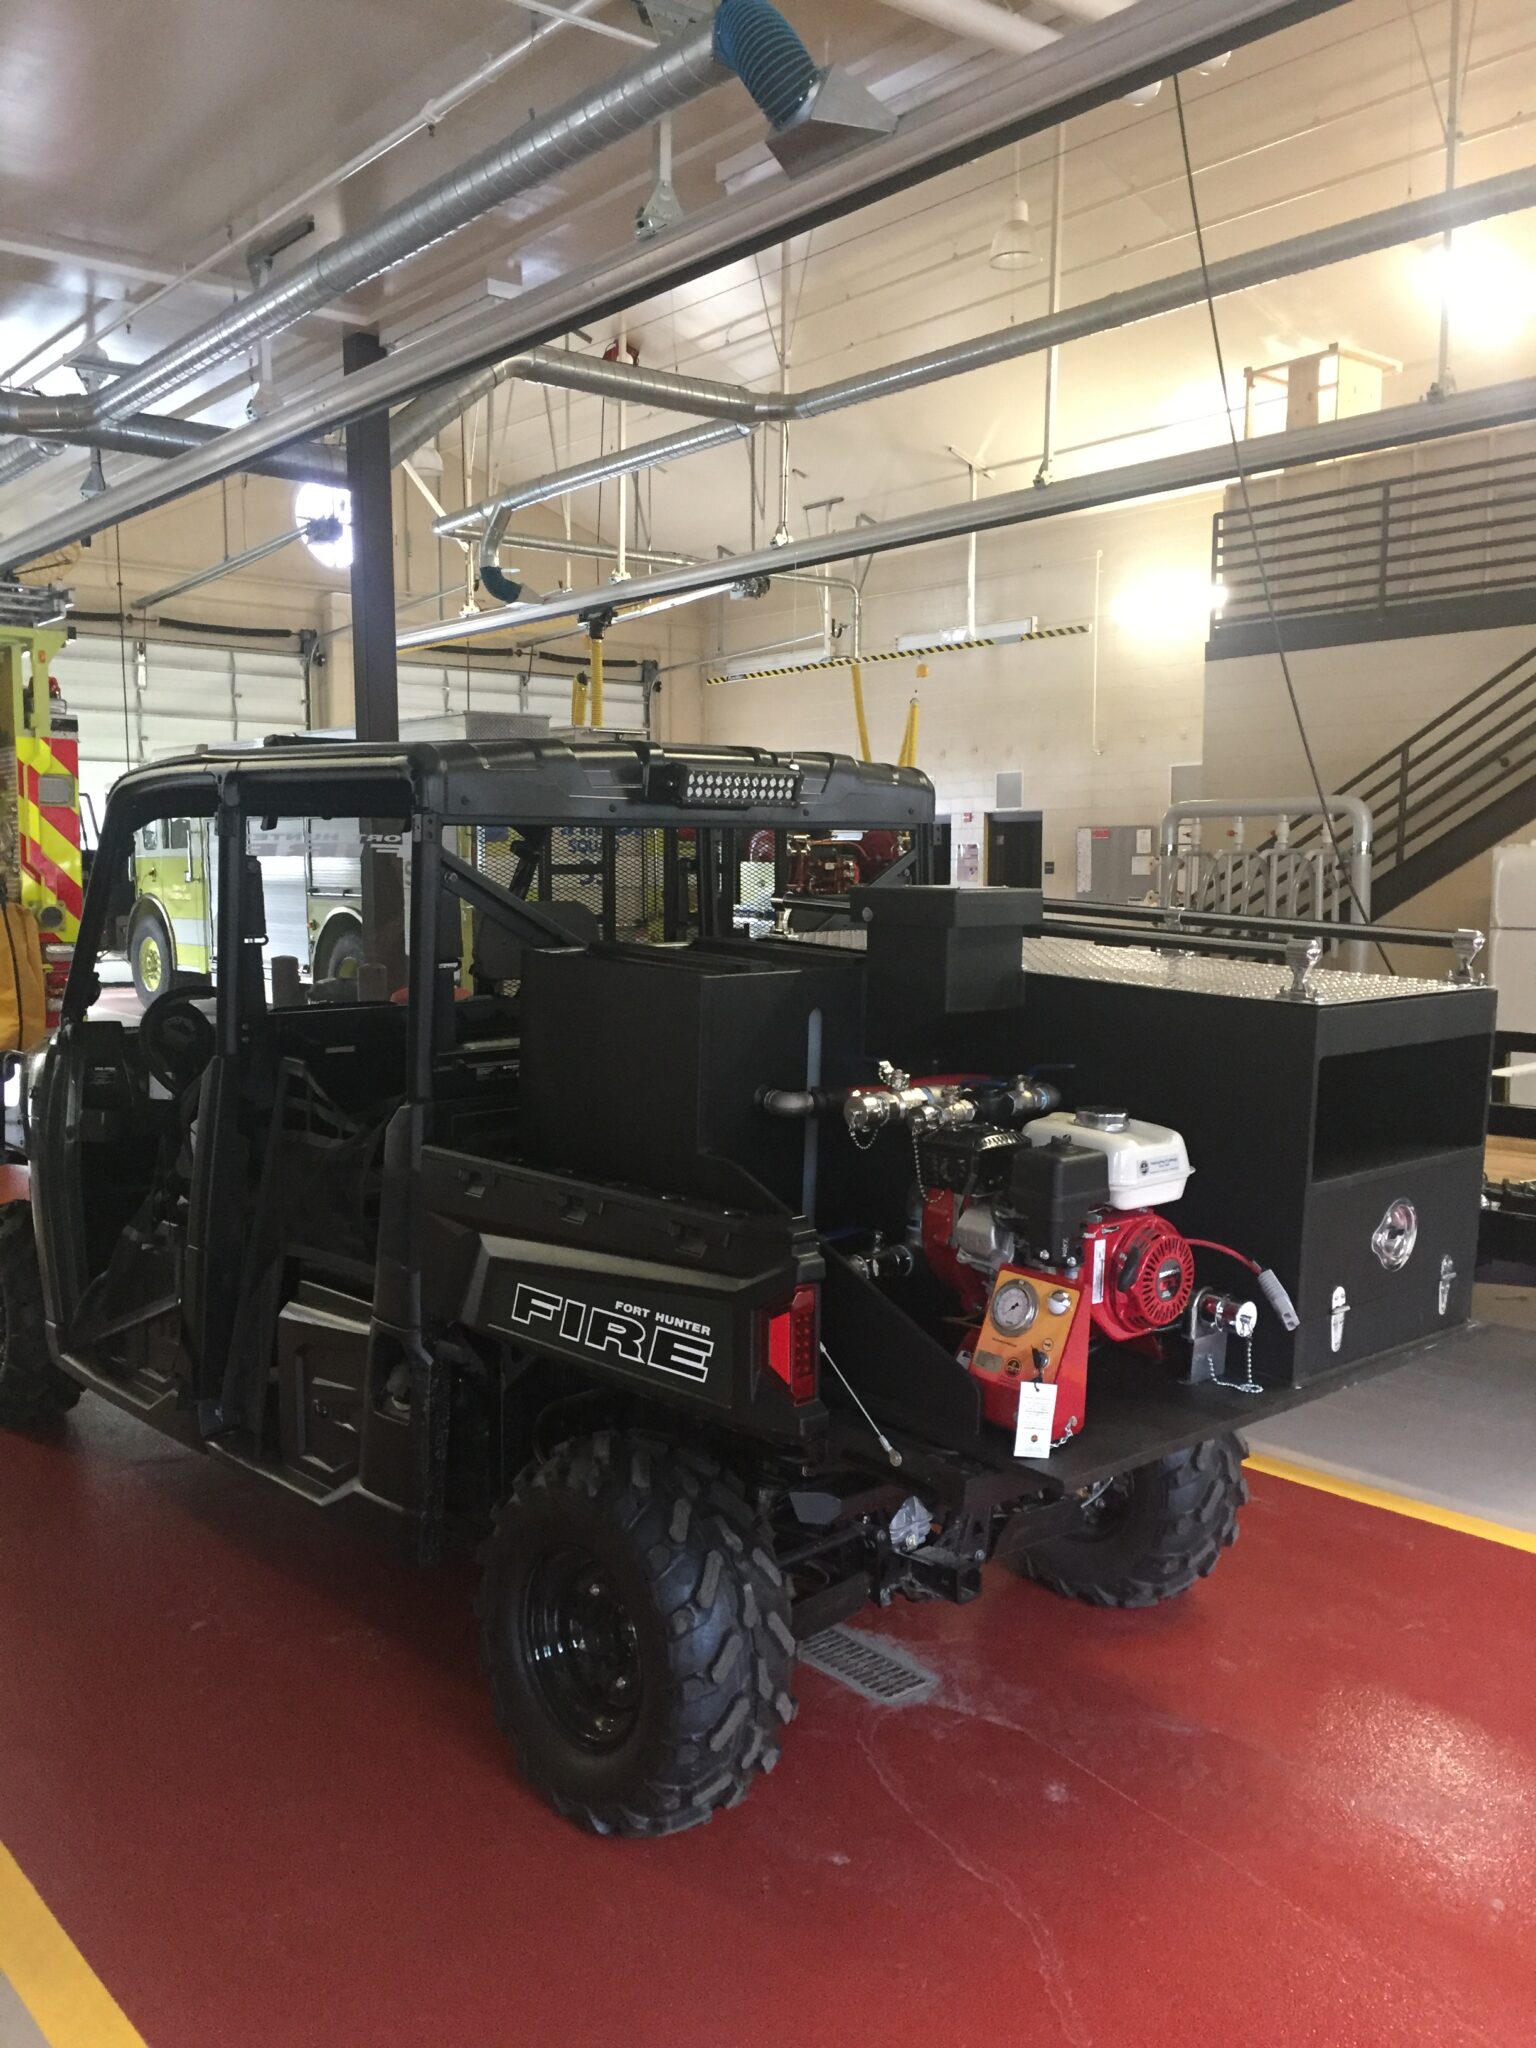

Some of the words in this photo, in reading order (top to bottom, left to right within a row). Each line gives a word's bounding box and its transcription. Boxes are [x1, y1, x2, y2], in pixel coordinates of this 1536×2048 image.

[511, 1283, 714, 1383] FIRE
[615, 1300, 650, 1318] FORT
[655, 1312, 711, 1336] HUNTER
